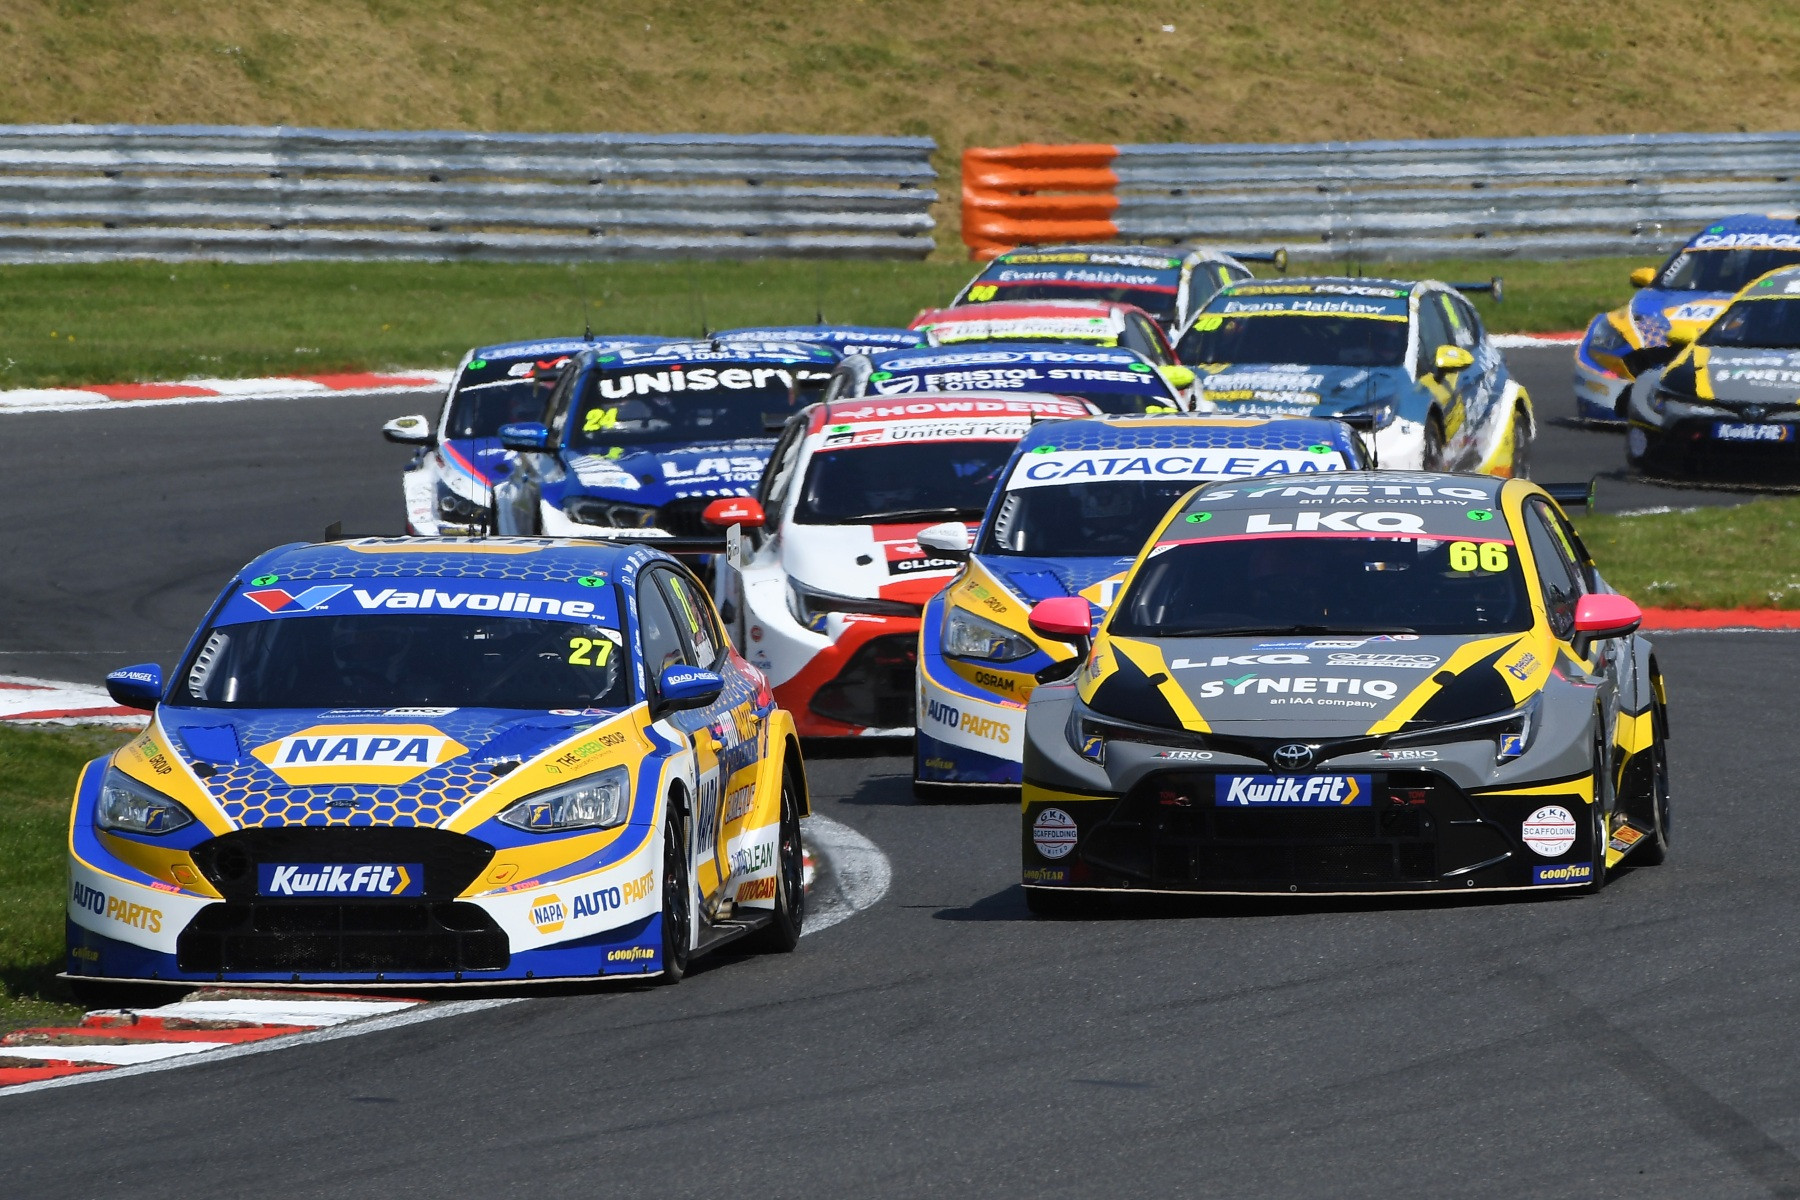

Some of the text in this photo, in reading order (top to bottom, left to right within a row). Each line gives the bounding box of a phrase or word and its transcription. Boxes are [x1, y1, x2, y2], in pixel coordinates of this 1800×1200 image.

[1000, 269, 1158, 285] Evans Halshaw
[1224, 301, 1386, 315] Evans Halshaw
[1028, 351, 1136, 364] Tools
[1048, 368, 1154, 385] STREET
[876, 402, 1085, 416] HOWDENS
[583, 407, 618, 432] 24
[891, 424, 974, 440] United
[1026, 455, 1338, 481] CATACLEAN
[1199, 484, 1490, 502] SYNETIQ
[1331, 497, 1368, 505] IAA
[1374, 498, 1468, 506] company
[1245, 511, 1427, 534] LKQ
[1449, 541, 1508, 572] 66
[353, 588, 596, 618] Valvoline
[568, 637, 613, 667] 27
[1171, 654, 1311, 669] LKQ
[126, 671, 153, 682] ANGEL
[667, 673, 694, 685] ROAD
[975, 671, 1014, 691] OSRAM
[1200, 673, 1398, 700] SYNETIQ
[1290, 697, 1313, 705] IAA
[1317, 699, 1377, 709] company
[928, 699, 959, 728] AUTO
[960, 712, 1011, 744] PARTS
[285, 738, 429, 763] NAPA
[557, 753, 581, 767] THE
[599, 732, 626, 747] GROUP
[1168, 751, 1213, 759] TRIO
[1041, 811, 1066, 823] GKR
[1536, 808, 1567, 821] GKR
[1033, 830, 1076, 838] SCAFFOLDING
[1523, 827, 1575, 836] SCAFFOLDING
[1540, 864, 1590, 881] GOODYEAR
[534, 869, 655, 925] NAPA AUTO PARTS
[73, 881, 163, 934] AUTO PARTS
[607, 946, 655, 962] GOODYEAR
